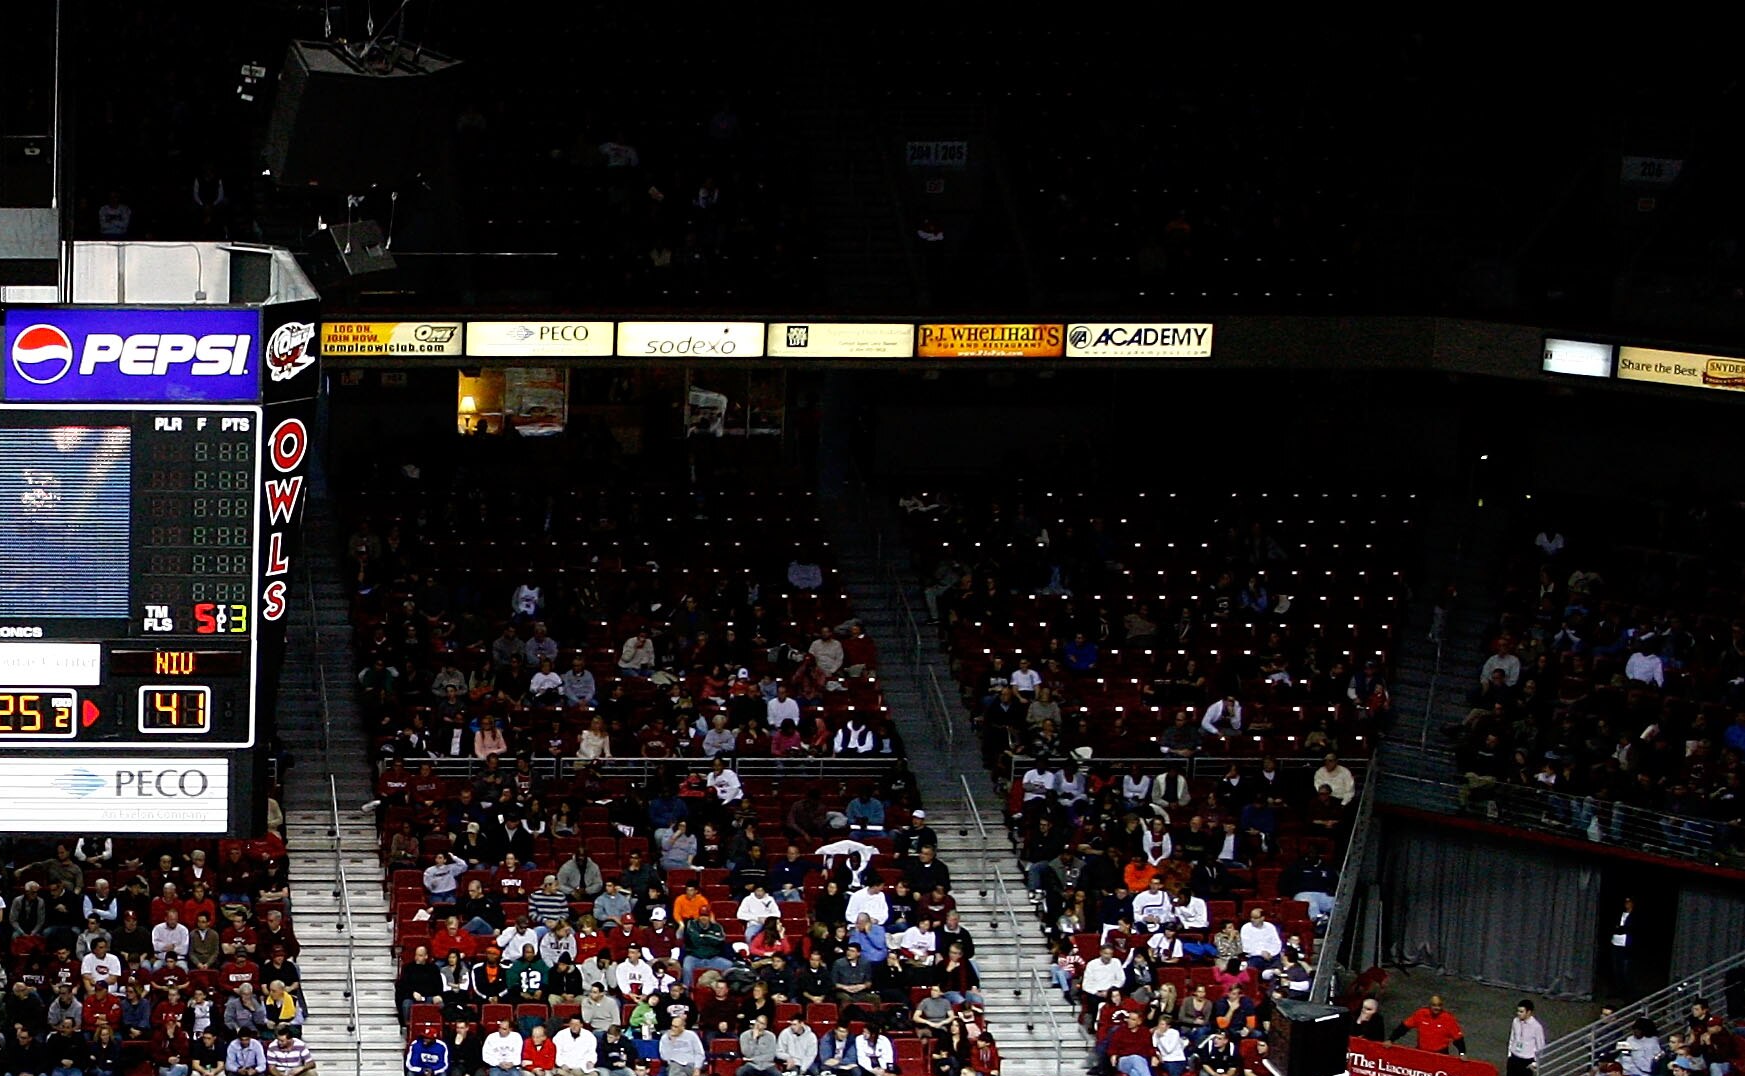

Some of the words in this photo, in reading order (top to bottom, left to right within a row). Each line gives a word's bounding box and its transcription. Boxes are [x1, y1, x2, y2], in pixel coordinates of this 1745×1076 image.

[334, 324, 354, 333] LOG
[539, 325, 590, 341] PECO
[1092, 327, 1209, 347] ACADEMY
[79, 333, 252, 376] PEPSI
[644, 335, 736, 355] sodexo
[1621, 358, 1652, 372] Share
[1654, 363, 1672, 374] the
[155, 417, 183, 431] PLR
[197, 417, 207, 431] F
[221, 417, 250, 432] PTS
[263, 418, 307, 621] OWLS
[145, 605, 168, 618] TM
[193, 603, 216, 634] 5
[230, 604, 248, 633] 3
[143, 618, 173, 632] FLS
[155, 651, 194, 675] NIU
[55, 707, 69, 728] 2
[155, 692, 204, 726] 41
[115, 768, 209, 797] PECO
[520, 971, 541, 993] 12
[1351, 1052, 1375, 1069] The
